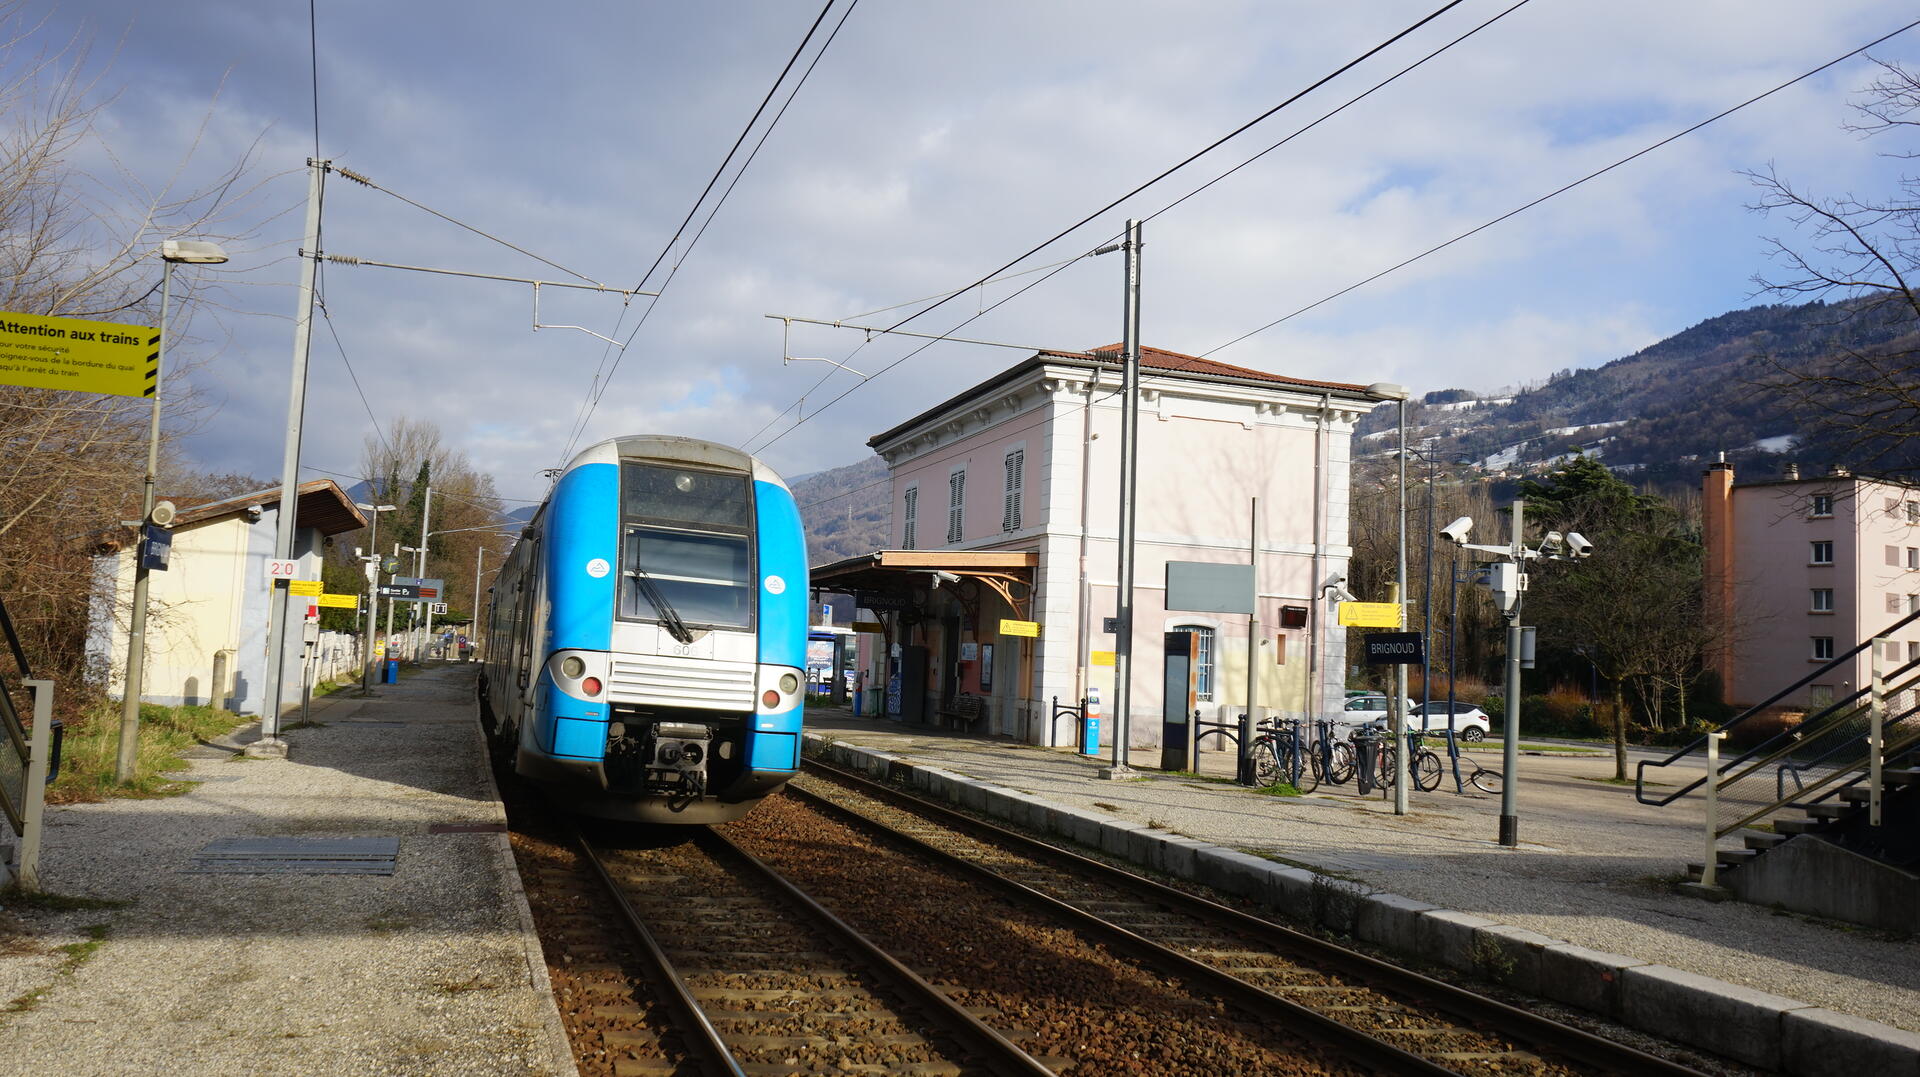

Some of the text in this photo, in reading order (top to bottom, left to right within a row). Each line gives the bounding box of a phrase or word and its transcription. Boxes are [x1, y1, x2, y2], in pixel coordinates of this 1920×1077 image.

[0, 319, 139, 346] Attention aux trains
[15, 343, 36, 351] votre
[0, 353, 48, 363] oignez-vous
[105, 362, 117, 370] du
[1371, 643, 1415, 654] BRIGNOUD
